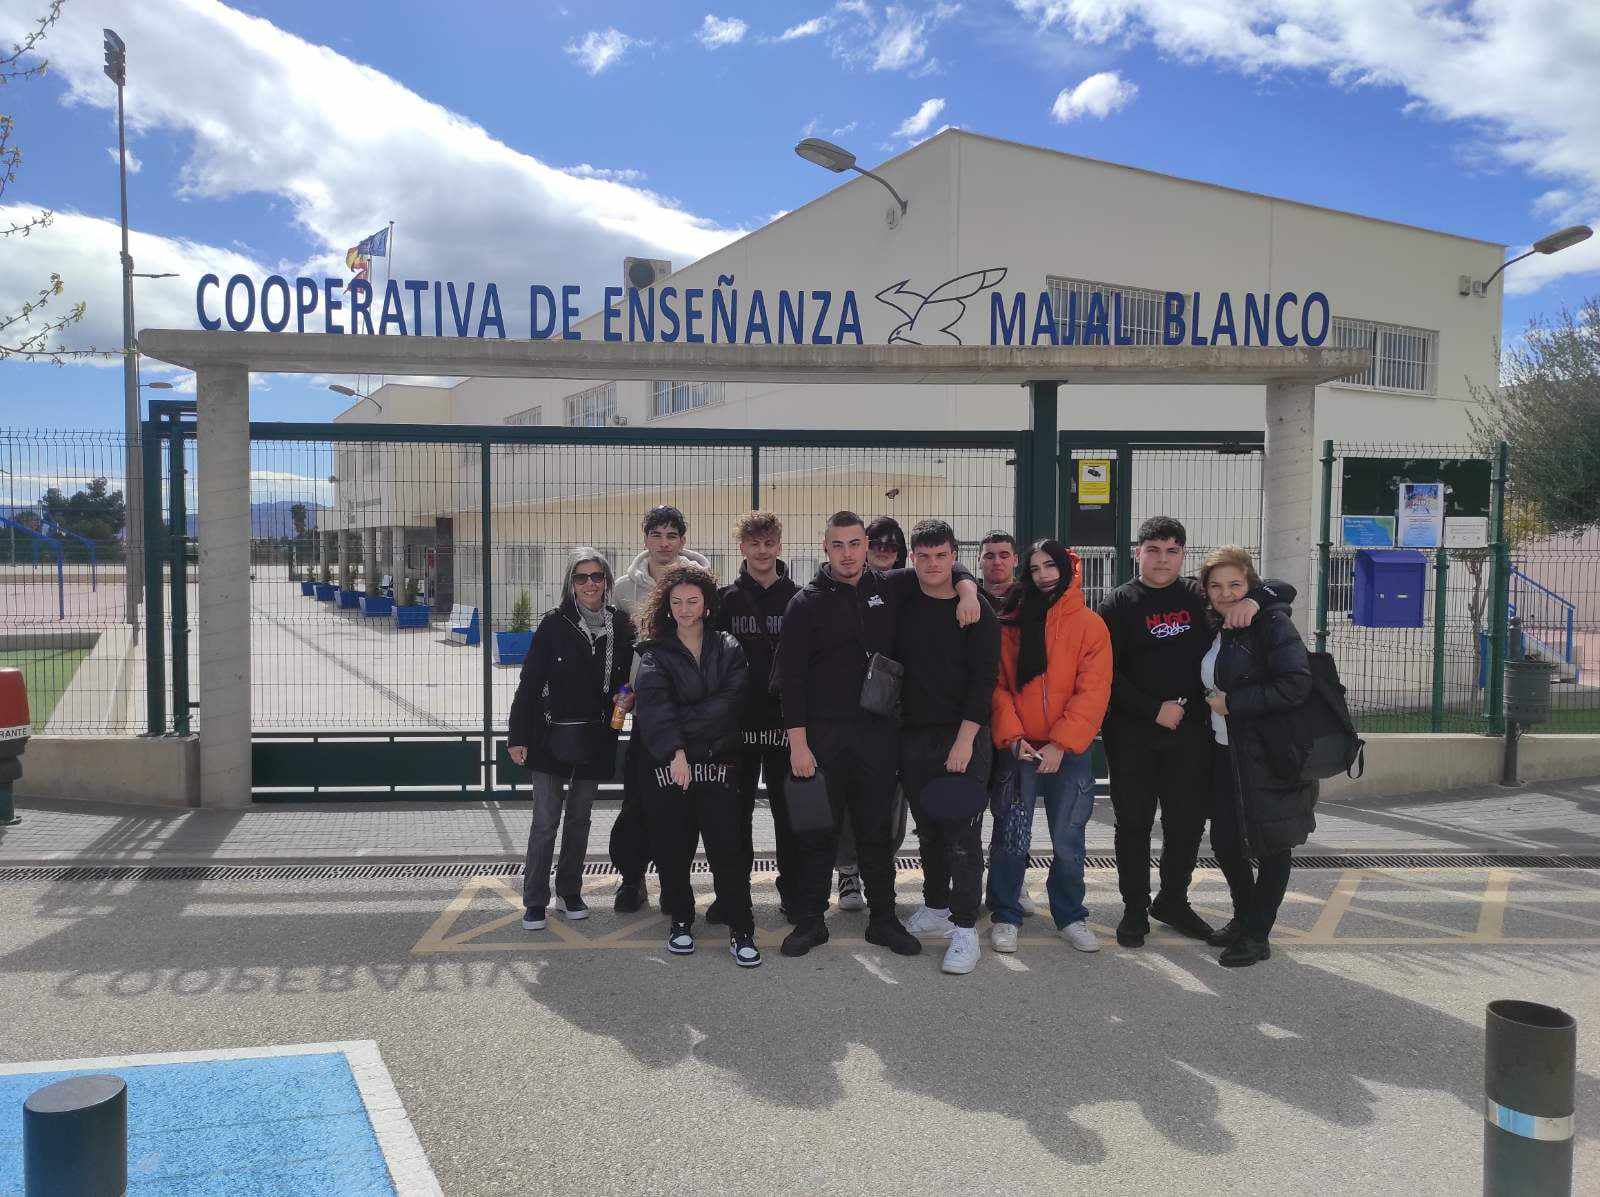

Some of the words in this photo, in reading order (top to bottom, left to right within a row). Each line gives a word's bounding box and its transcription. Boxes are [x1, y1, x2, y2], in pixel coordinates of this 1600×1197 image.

[196, 273, 506, 339] COOPERATIVA
[530, 284, 582, 341] DE
[603, 274, 864, 345] ENSEÑANZA
[990, 291, 1136, 346] MAJAL
[1163, 291, 1330, 347] BLANCO
